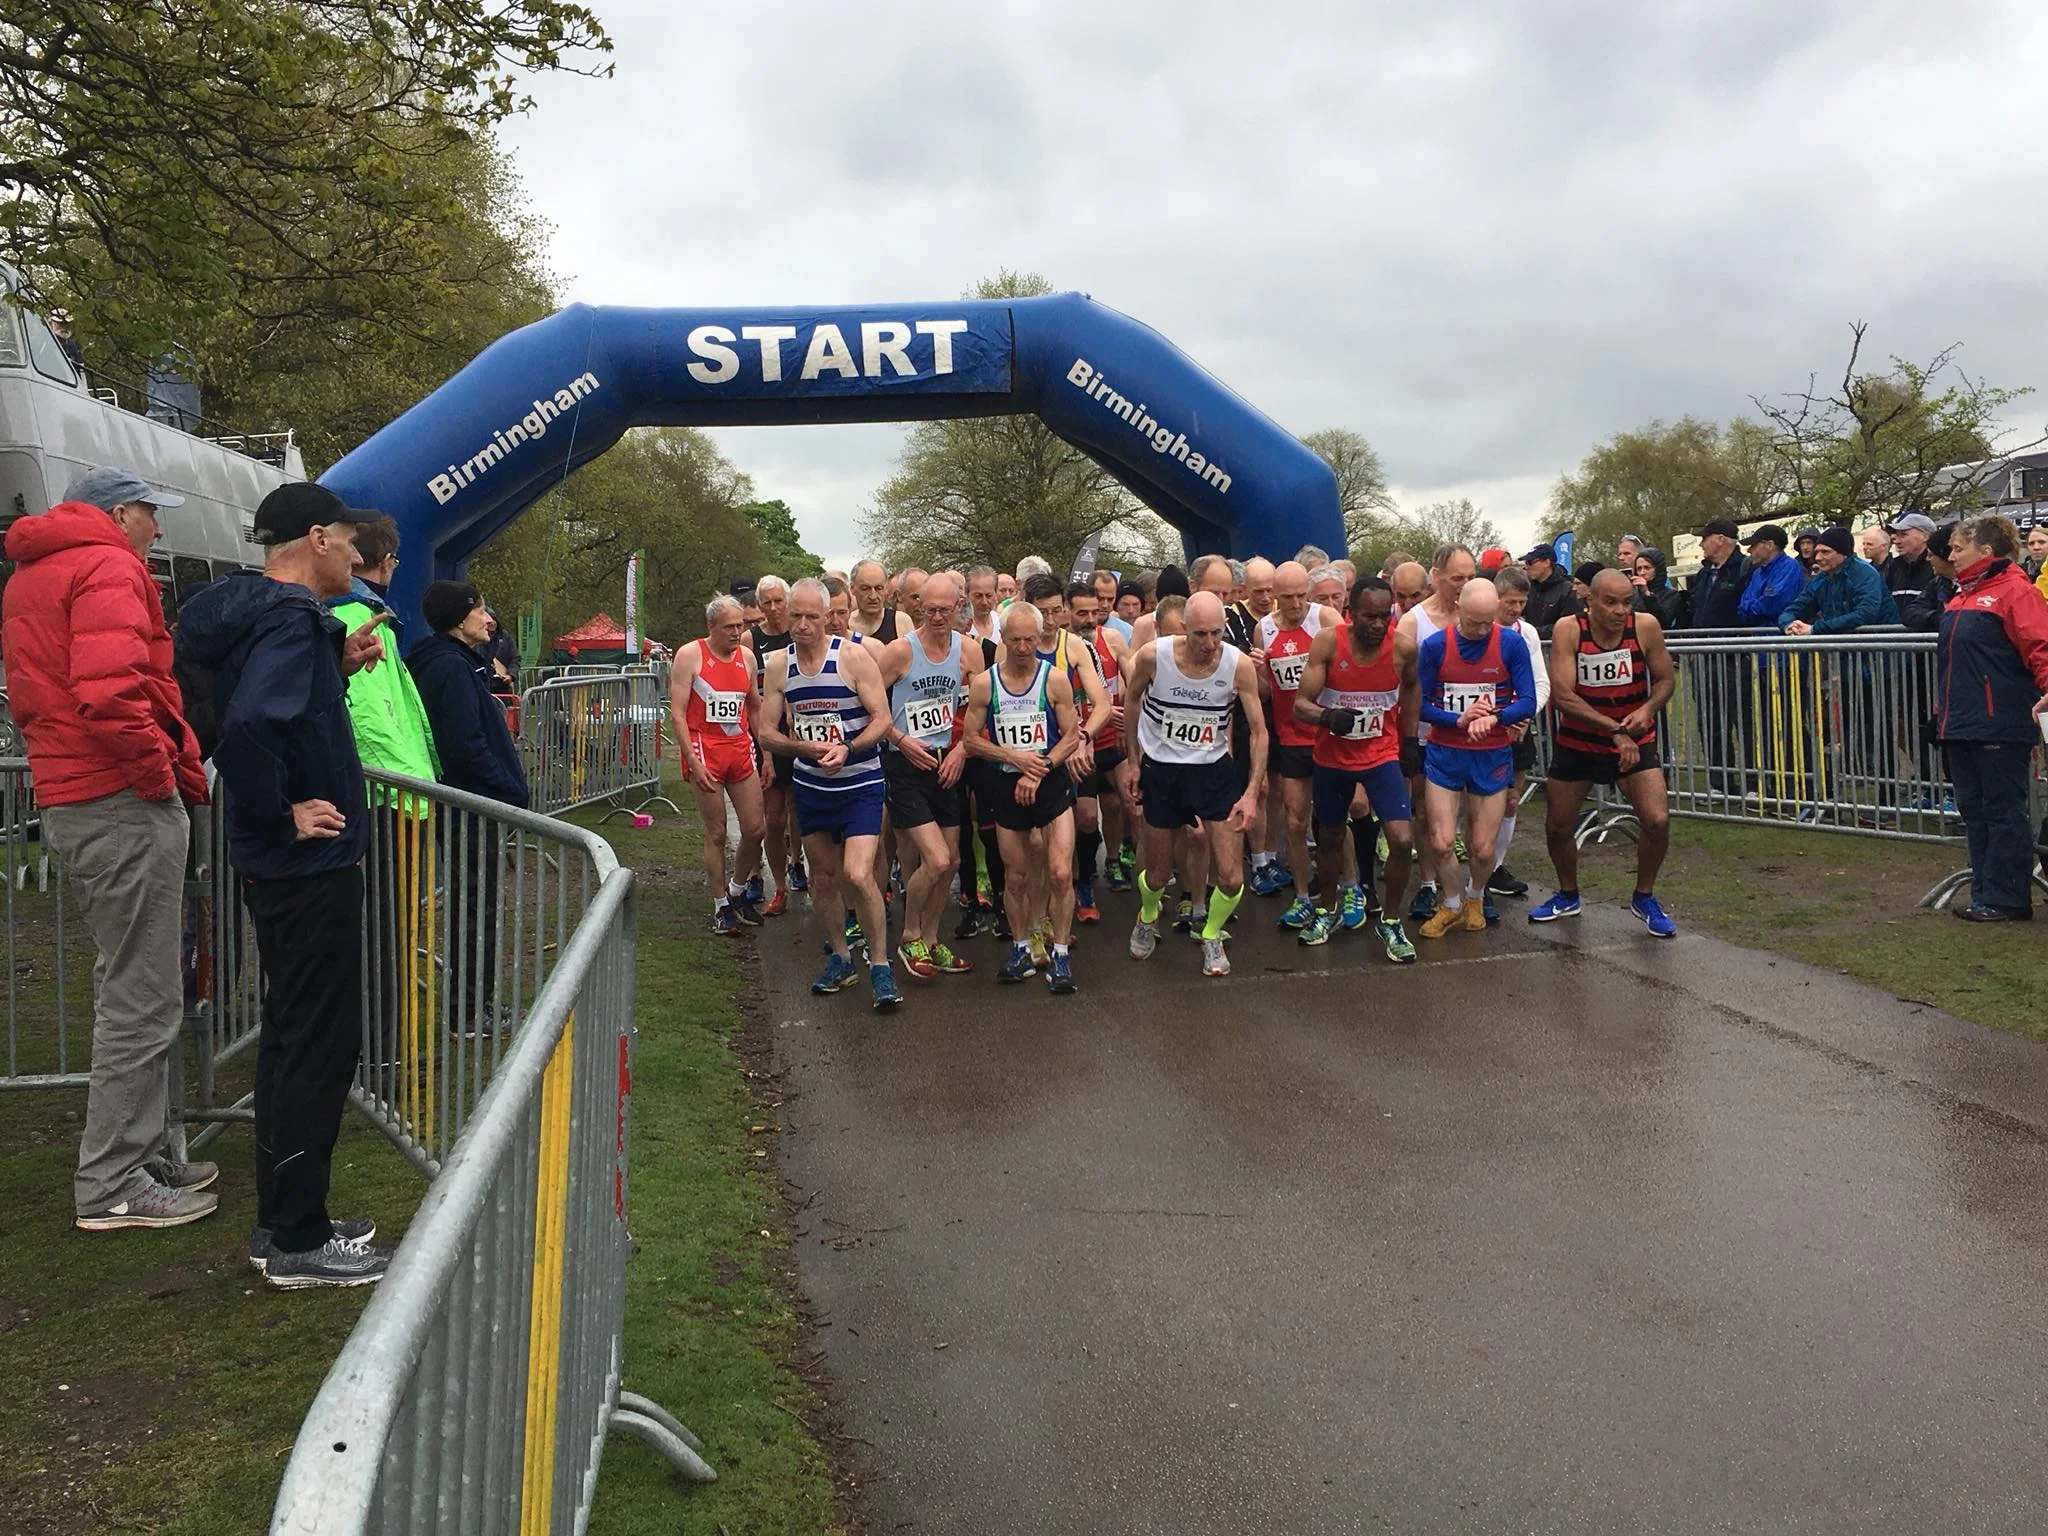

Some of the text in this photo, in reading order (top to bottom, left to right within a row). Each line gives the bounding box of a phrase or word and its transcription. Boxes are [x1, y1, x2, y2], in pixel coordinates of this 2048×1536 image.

[686, 320, 968, 384] START
[1066, 358, 1233, 494] Birmingham
[426, 371, 601, 506] Birmingham
[1613, 651, 1630, 661] M55
[1579, 660, 1631, 681] 118A
[911, 675, 957, 692] SHEFFIELD
[1478, 685, 1495, 693] M55
[795, 701, 839, 711] CENTURION
[937, 696, 952, 705] M55
[1000, 699, 1037, 707] DONCASTER
[823, 714, 840, 724] M55
[909, 704, 952, 731] 130A
[1029, 714, 1046, 723] M55
[1200, 716, 1218, 725] M55
[796, 724, 843, 743] 113A
[997, 723, 1046, 745] 115A
[1164, 721, 1214, 744] 140A
